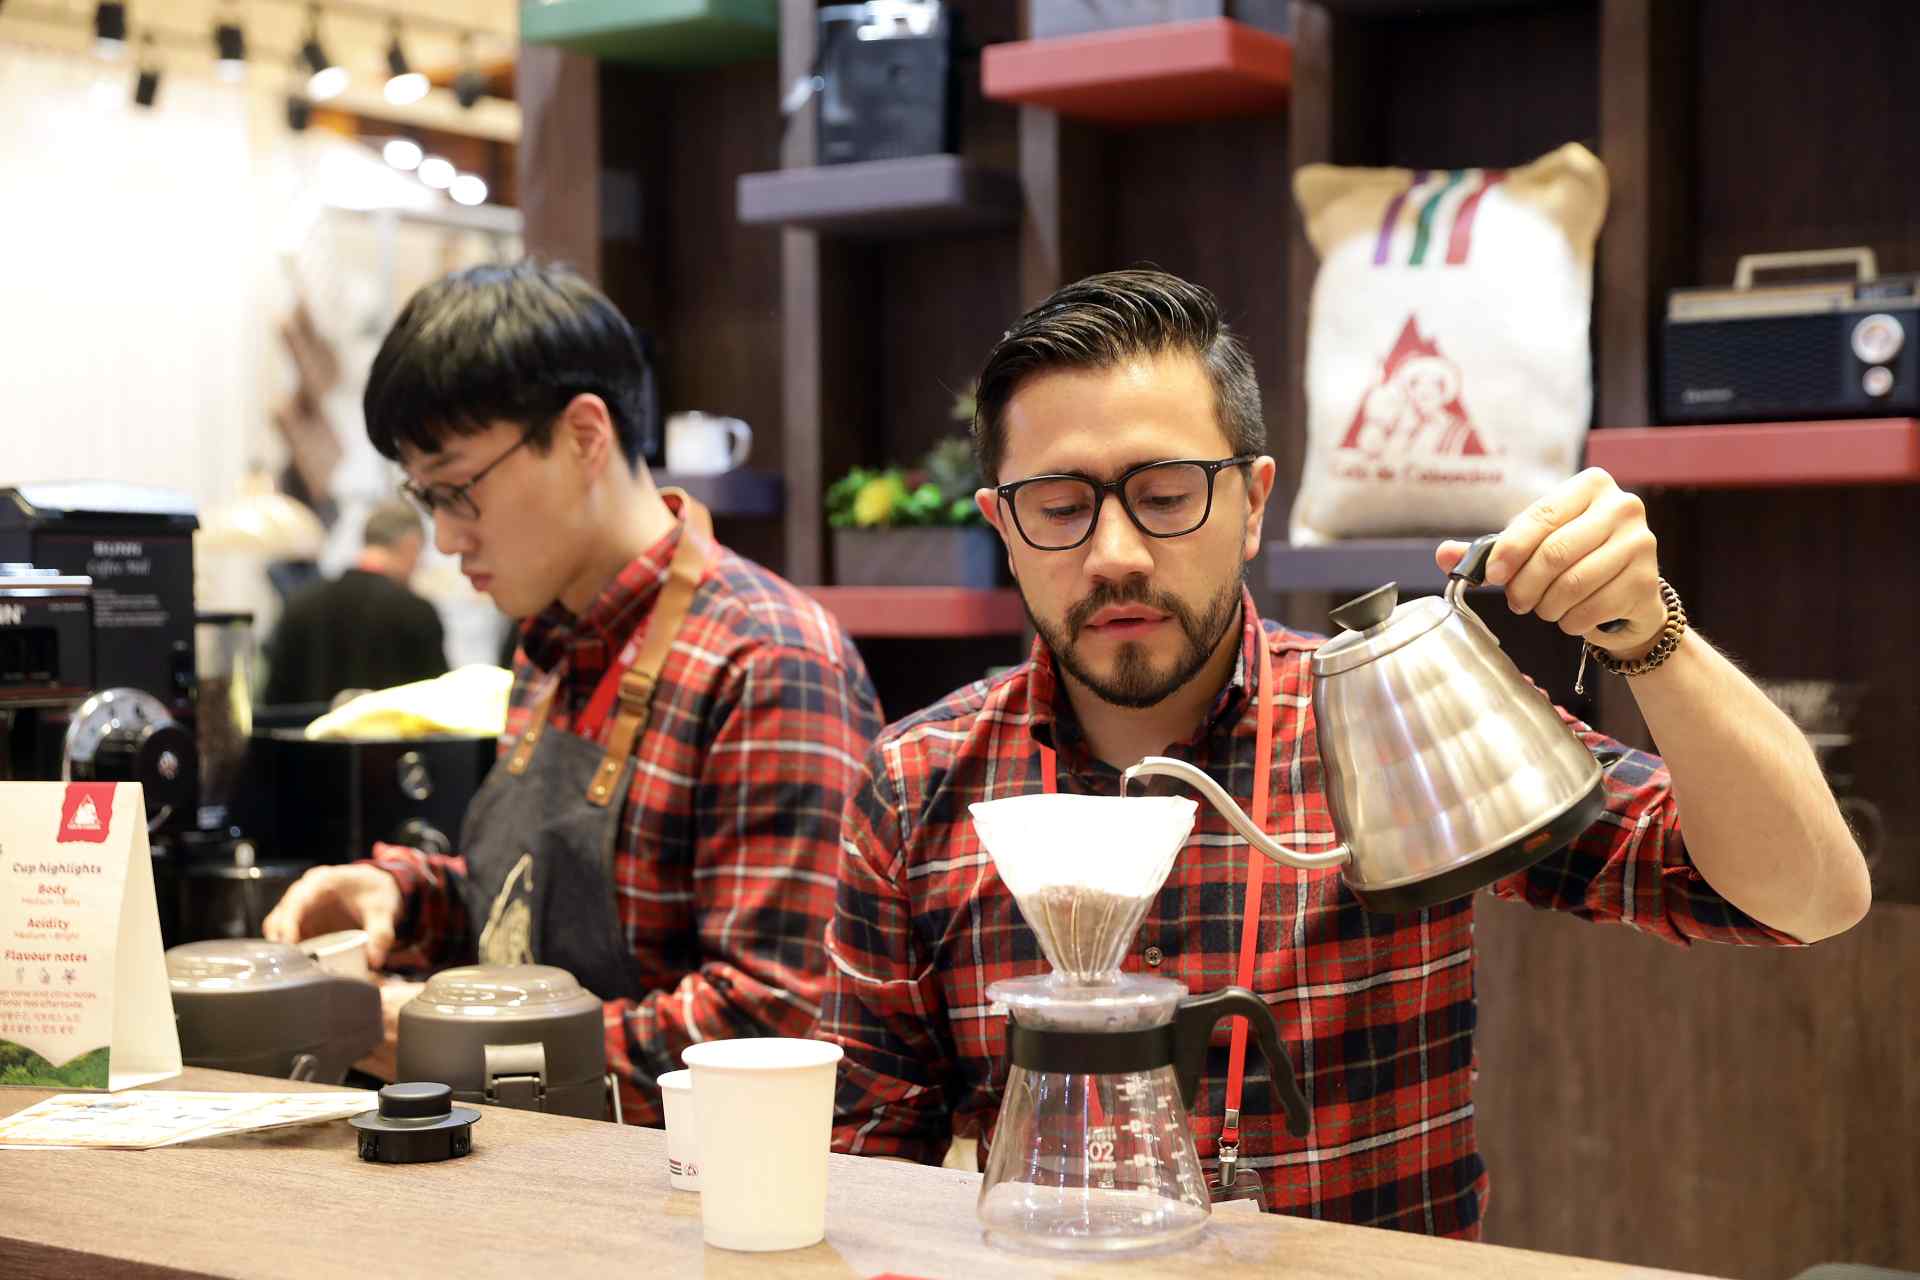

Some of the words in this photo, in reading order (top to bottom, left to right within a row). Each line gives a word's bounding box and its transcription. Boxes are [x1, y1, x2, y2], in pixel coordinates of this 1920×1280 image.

[12, 862, 37, 875] Cup
[39, 861, 102, 875] highlights
[38, 883, 67, 896] Body
[27, 917, 70, 930] Acidity
[4, 950, 51, 962] Flavour
[54, 952, 88, 962] notes
[1089, 1141, 1115, 1162] 02
